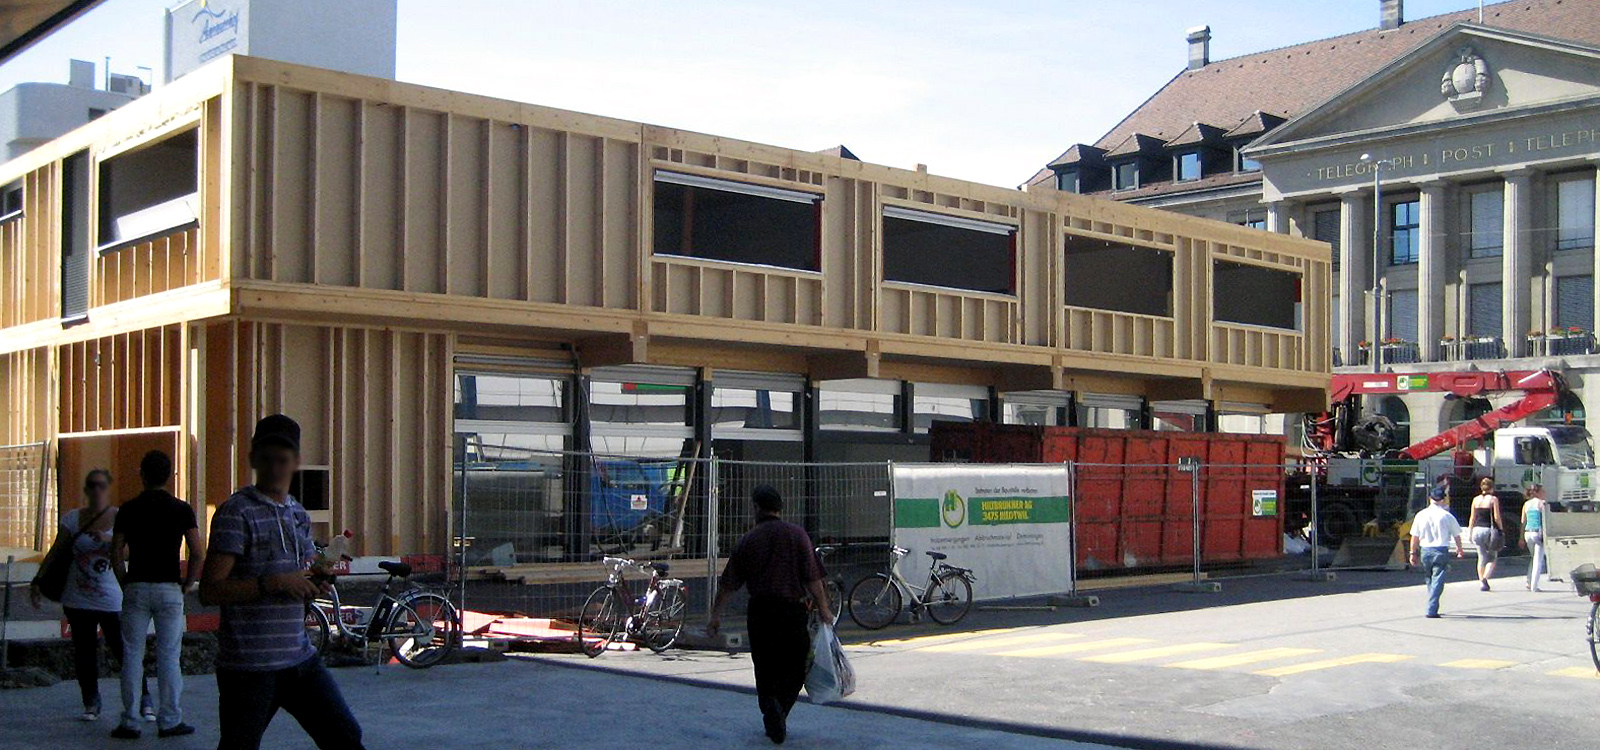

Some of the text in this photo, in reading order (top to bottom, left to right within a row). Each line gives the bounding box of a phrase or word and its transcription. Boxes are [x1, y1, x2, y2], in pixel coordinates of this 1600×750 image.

[1317, 155, 1413, 180] TELEGRPH
[1442, 143, 1495, 163] POST
[1024, 500, 1033, 509] AG
[982, 511, 999, 521] 3475
